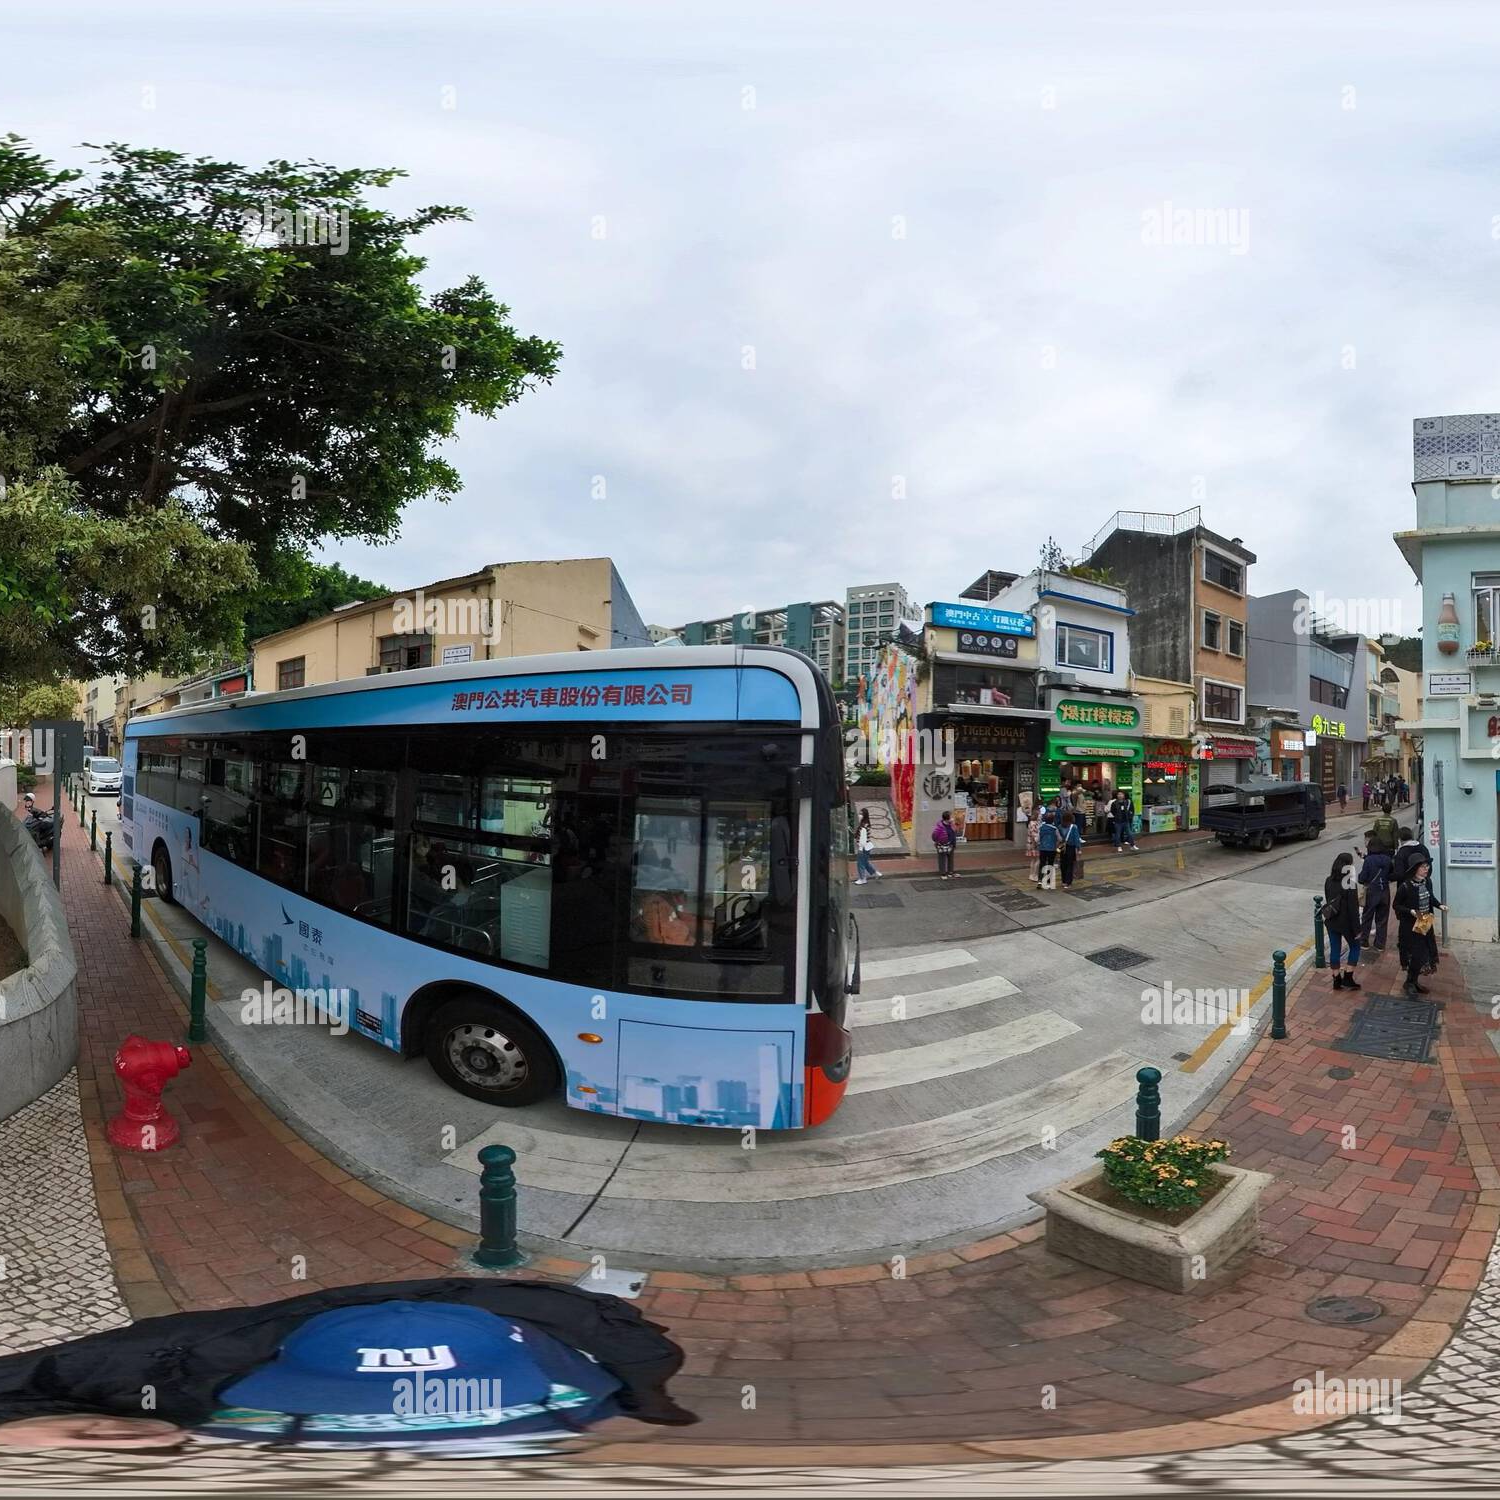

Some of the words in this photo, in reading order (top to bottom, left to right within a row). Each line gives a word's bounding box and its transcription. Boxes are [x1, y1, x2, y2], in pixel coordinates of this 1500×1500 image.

[451, 683, 693, 711] 澳門公共汽車股份有限公司
[1059, 704, 1135, 725] 爆打檸檬茶
[962, 724, 991, 737] TIGER
[993, 726, 1026, 738] SUGAR
[299, 920, 323, 945] 國泰
